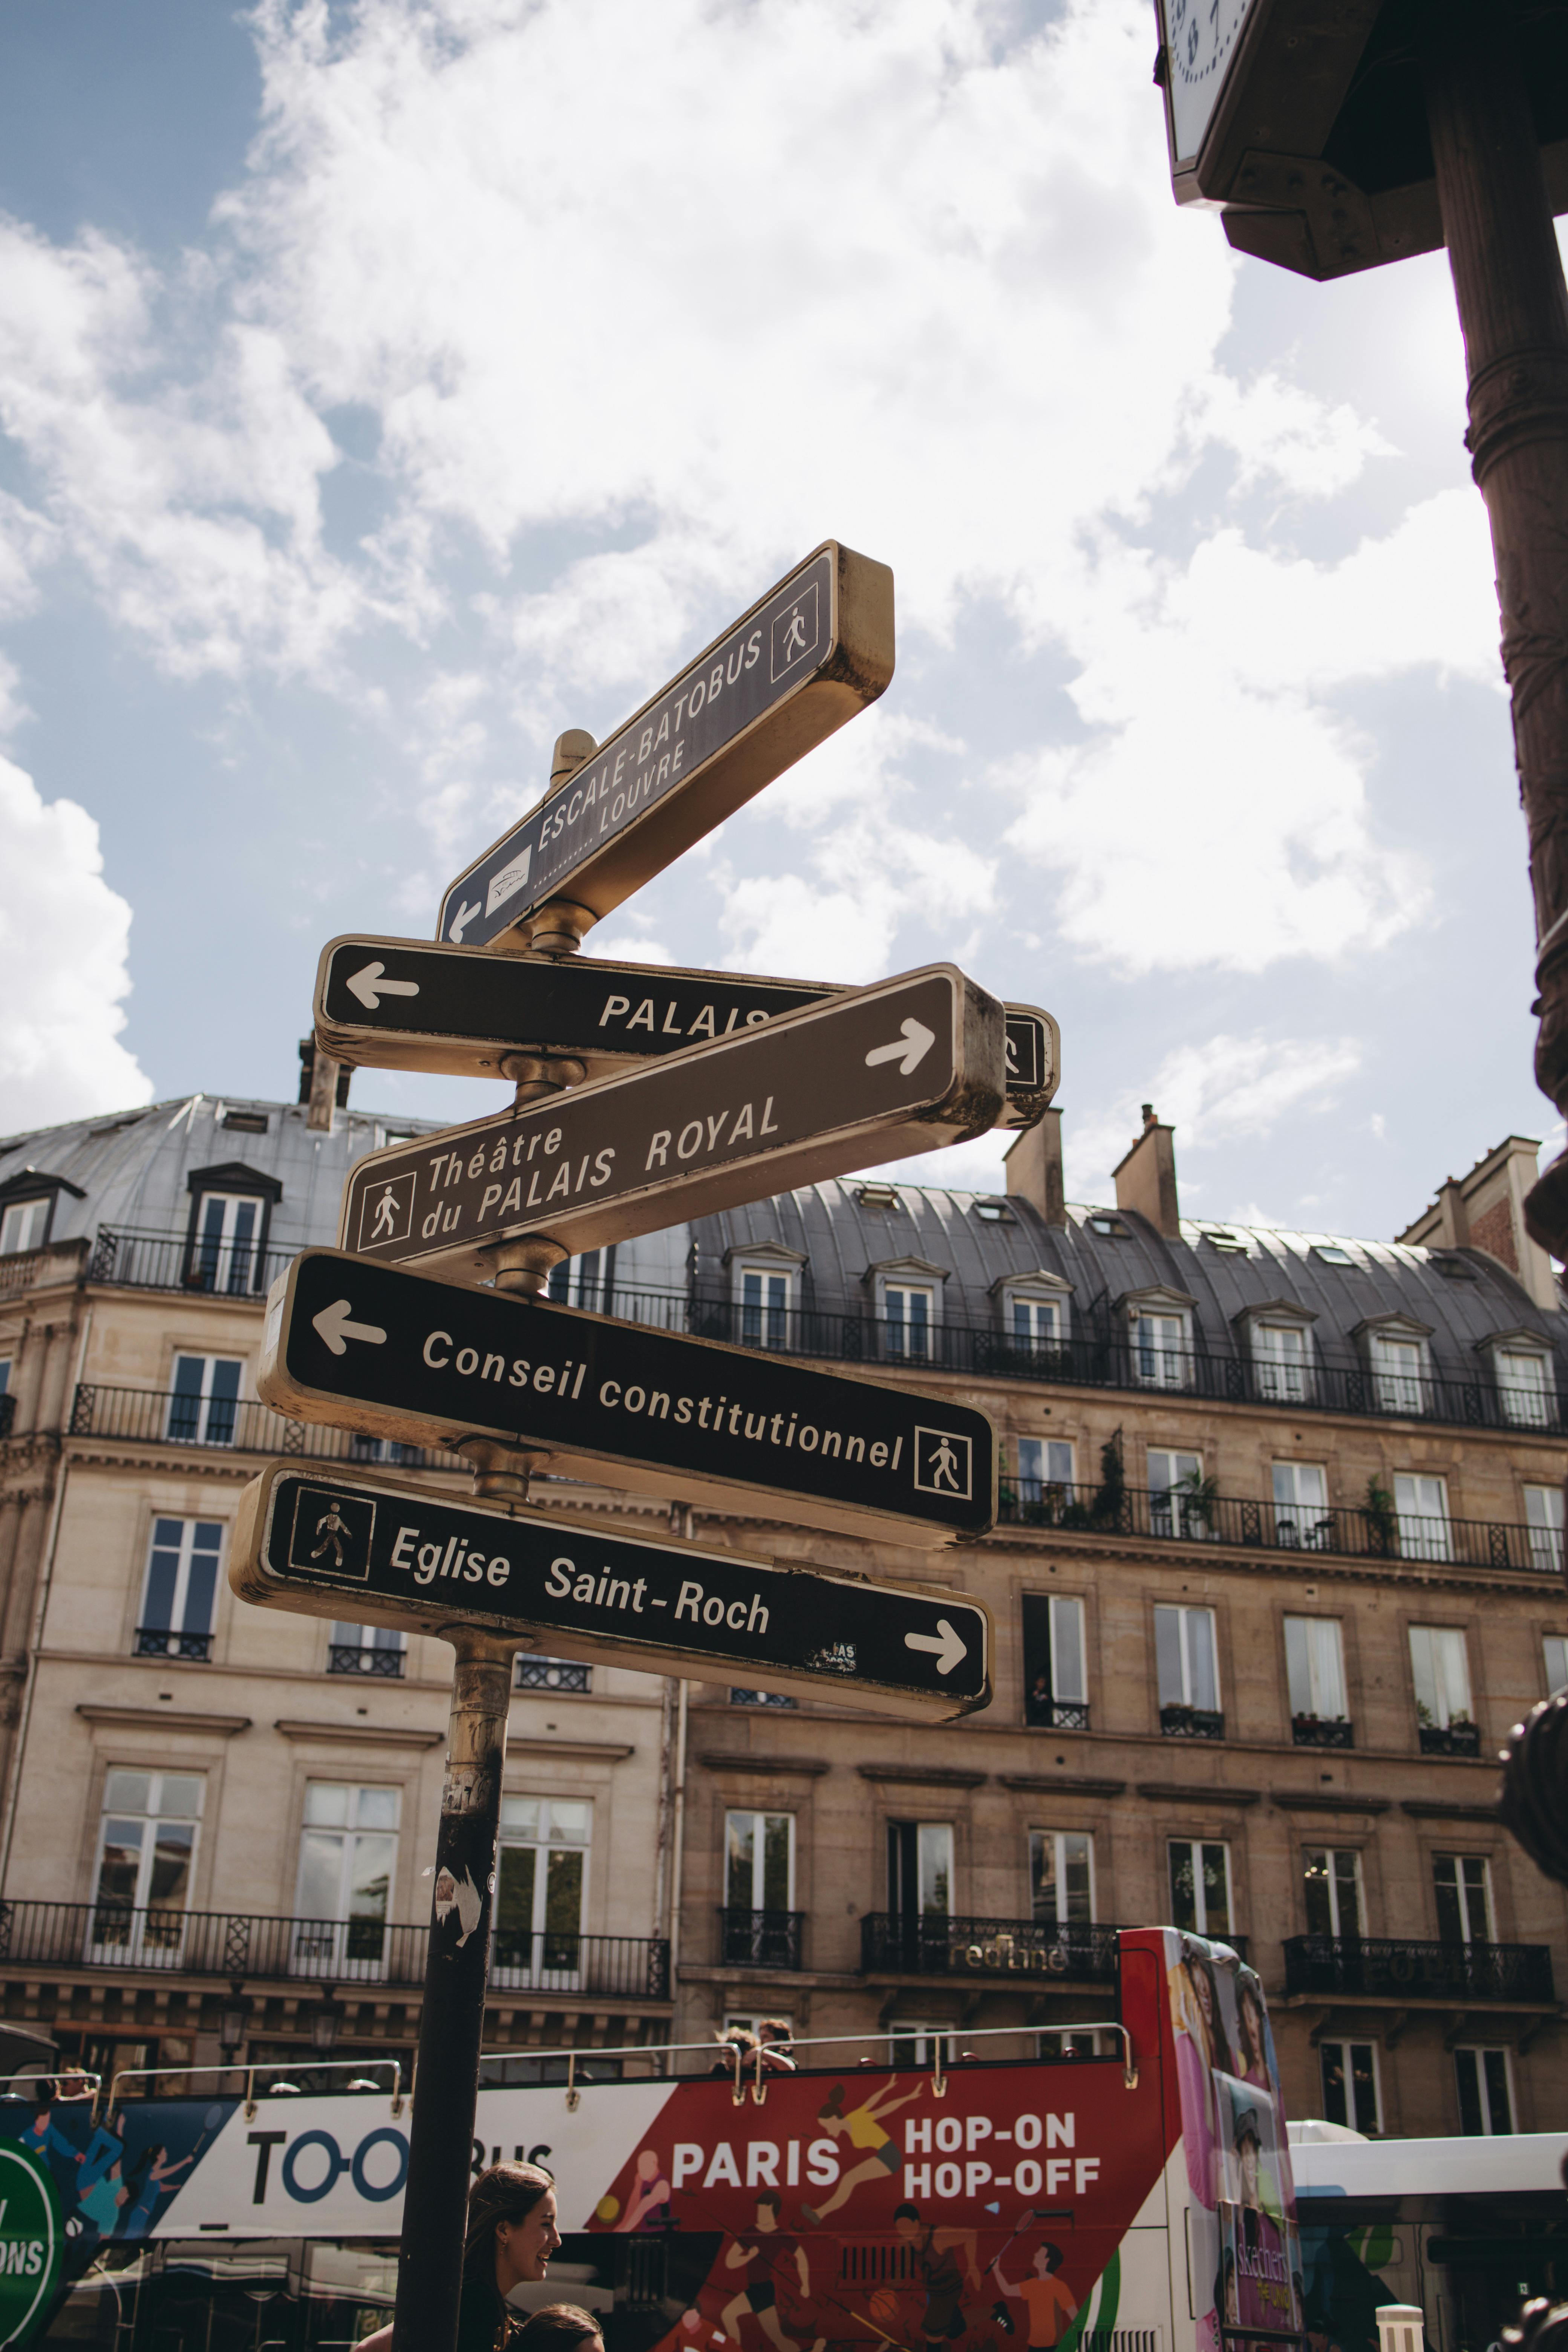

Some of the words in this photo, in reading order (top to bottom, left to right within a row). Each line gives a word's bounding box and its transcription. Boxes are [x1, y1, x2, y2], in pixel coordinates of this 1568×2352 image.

[1188, 18, 1199, 66] 8
[537, 630, 762, 852] ESCALE-BATOBUS
[599, 740, 685, 834] LOUVRE
[422, 1201, 462, 1239] du
[477, 1148, 616, 1222] PALAIS
[645, 1096, 779, 1171] ROYAL
[429, 1128, 562, 1192] Théâtre
[423, 1331, 586, 1399] Conseil
[600, 1381, 903, 1470] constitutionnel
[390, 1527, 510, 1586] Eglise
[545, 1557, 769, 1634] Saint-Roch
[672, 2139, 840, 2188] PARIS
[905, 2113, 1075, 2153] HOP-ON
[905, 2158, 1100, 2199] HOP-OFF
